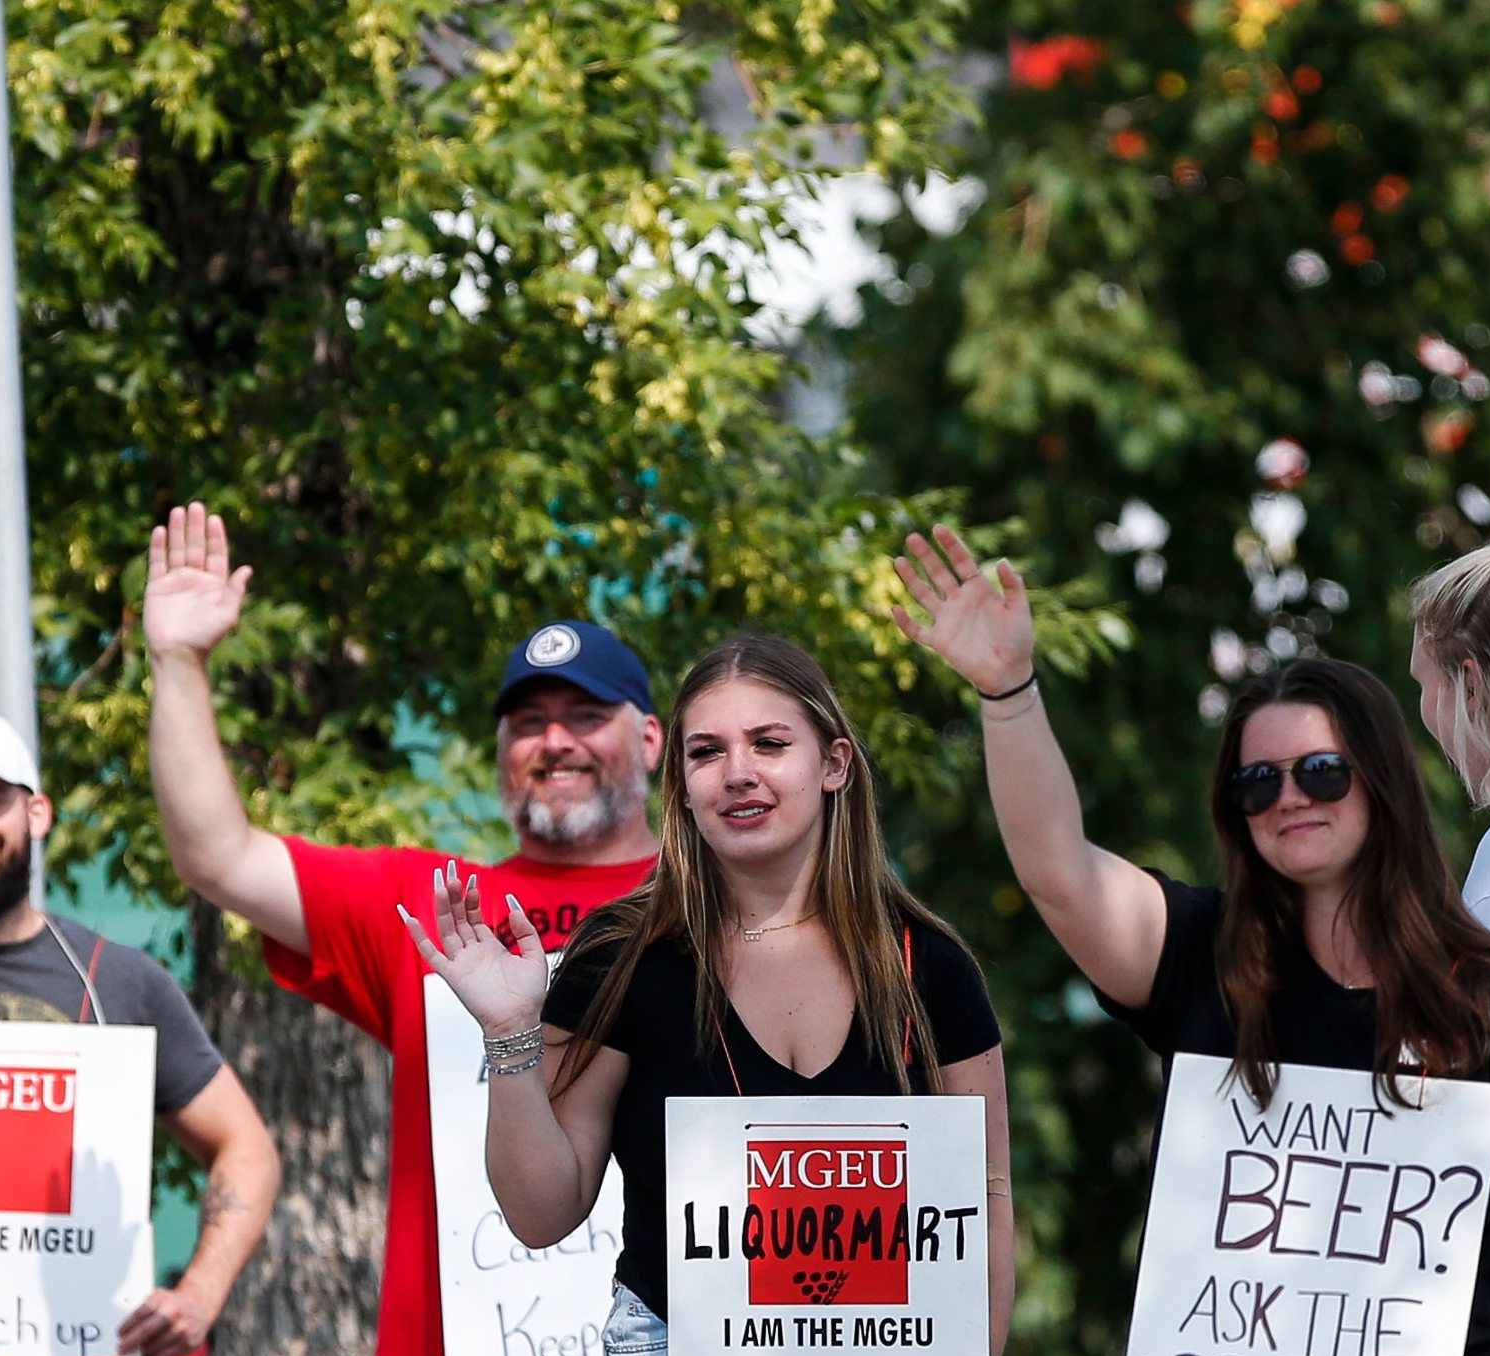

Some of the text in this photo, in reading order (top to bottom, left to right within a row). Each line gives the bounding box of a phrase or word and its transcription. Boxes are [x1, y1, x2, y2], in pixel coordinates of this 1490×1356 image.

[1231, 1097, 1389, 1155] WANT
[746, 1149, 908, 1189] MGEU
[19, 1226, 96, 1255] MGEU
[683, 1199, 980, 1264] LIQUORMART
[1214, 1148, 1485, 1276] BEER?
[724, 1318, 934, 1348] I AM THE MGEU
[1177, 1275, 1286, 1351] ASK
